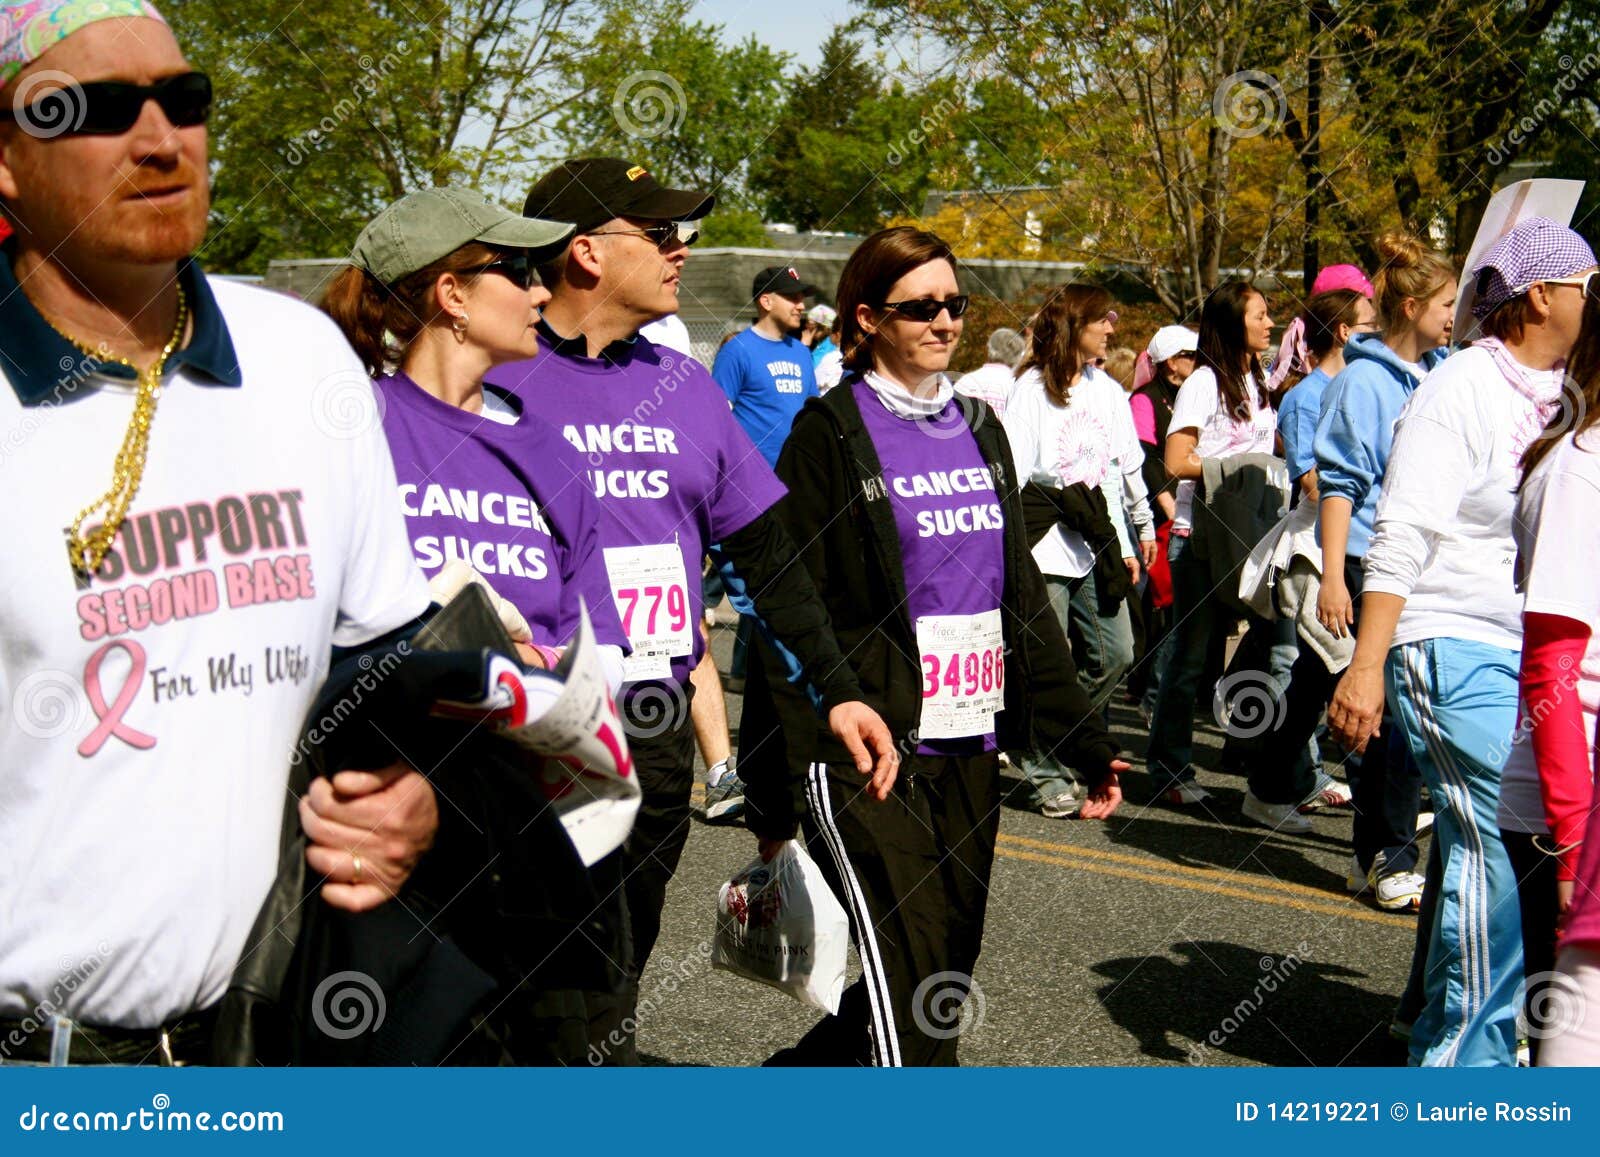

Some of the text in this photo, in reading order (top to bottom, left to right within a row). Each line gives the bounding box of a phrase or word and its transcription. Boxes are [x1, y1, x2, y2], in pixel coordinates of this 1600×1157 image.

[563, 424, 680, 454] ANCER
[587, 469, 670, 499] UCKS
[916, 504, 1004, 537] SUCKS
[414, 536, 548, 580] SUCKS
[77, 554, 316, 641] SECOND BASE
[208, 652, 253, 696] My
[921, 646, 1004, 698] 34986
[775, 944, 809, 956] PINK
